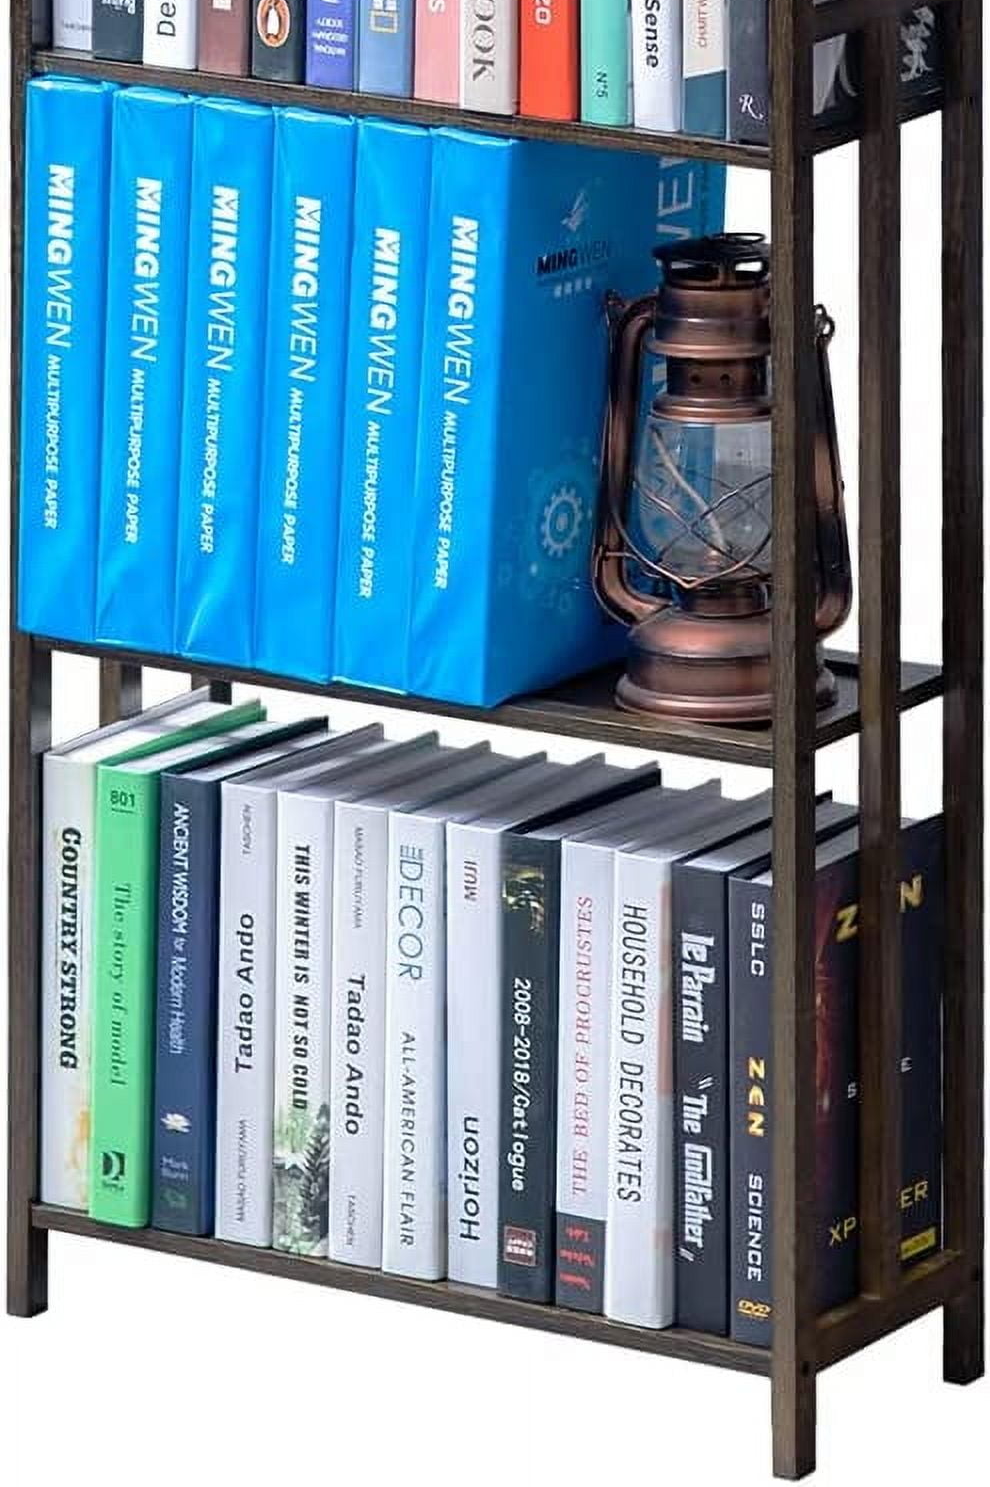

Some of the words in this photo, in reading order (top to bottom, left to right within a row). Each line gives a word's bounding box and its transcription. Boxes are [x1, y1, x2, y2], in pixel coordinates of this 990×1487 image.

[45, 163, 75, 348] MINGWEN
[130, 176, 162, 361] MINGWEN
[206, 185, 239, 371] MINGWEN
[288, 195, 322, 382] MINGWEN
[366, 227, 401, 415] MINGWEN
[443, 215, 479, 404] MINGWEN
[44, 353, 61, 473] MULTIPURPOSE
[127, 368, 146, 488] MULTIPURPOSE
[202, 377, 222, 498] MULTIPURPOSE
[283, 386, 305, 508] MULTIPURPOSE
[43, 478, 58, 529] PAPER
[359, 420, 382, 541] MULTIPURPOSE
[437, 409, 458, 532] MULTIPURPOSE
[124, 493, 140, 544] PAPER
[199, 503, 216, 553] PAPER
[281, 512, 297, 564] PAPER
[357, 546, 374, 597] PAPER
[434, 537, 451, 589] PAPER
[110, 790, 135, 808] 801
[172, 802, 189, 869] ANCIENT
[293, 843, 311, 886] THIS
[58, 826, 82, 953] COUNTRY
[112, 882, 131, 922] The
[172, 871, 189, 934] WISDOM
[462, 860, 477, 900] MUJI
[237, 913, 257, 984] Ando
[292, 892, 310, 959] WINTER
[397, 858, 424, 979] DECOR
[750, 902, 766, 977] SSLC
[109, 929, 128, 986] story
[170, 956, 187, 1006] Modern
[293, 964, 309, 983] IS
[574, 895, 593, 1042] PROCRUSTES
[620, 902, 649, 1044] HOUSEHOLD
[58, 960, 79, 1070] STRONG
[110, 991, 128, 1016] of
[170, 1010, 187, 1054] Health
[234, 992, 256, 1072] Tadao
[292, 993, 310, 1029] NOT
[346, 973, 367, 1053] Tadao
[110, 1021, 128, 1086] model
[292, 1034, 309, 1056] SO
[573, 1051, 589, 1080] OF
[291, 1063, 309, 1110] COLD
[345, 1064, 365, 1134] Ando
[400, 1032, 416, 1181] ALL-AMERICAN
[508, 977, 532, 1190] 2008-2018/Catlogue
[572, 1096, 588, 1136] BED
[748, 1056, 766, 1137] ZEN
[617, 1060, 645, 1203] DECORATES
[458, 1116, 480, 1240] Horizon
[571, 1147, 586, 1195] THE
[399, 1190, 415, 1245] FLAIR
[747, 1173, 765, 1281] SCIENCE
